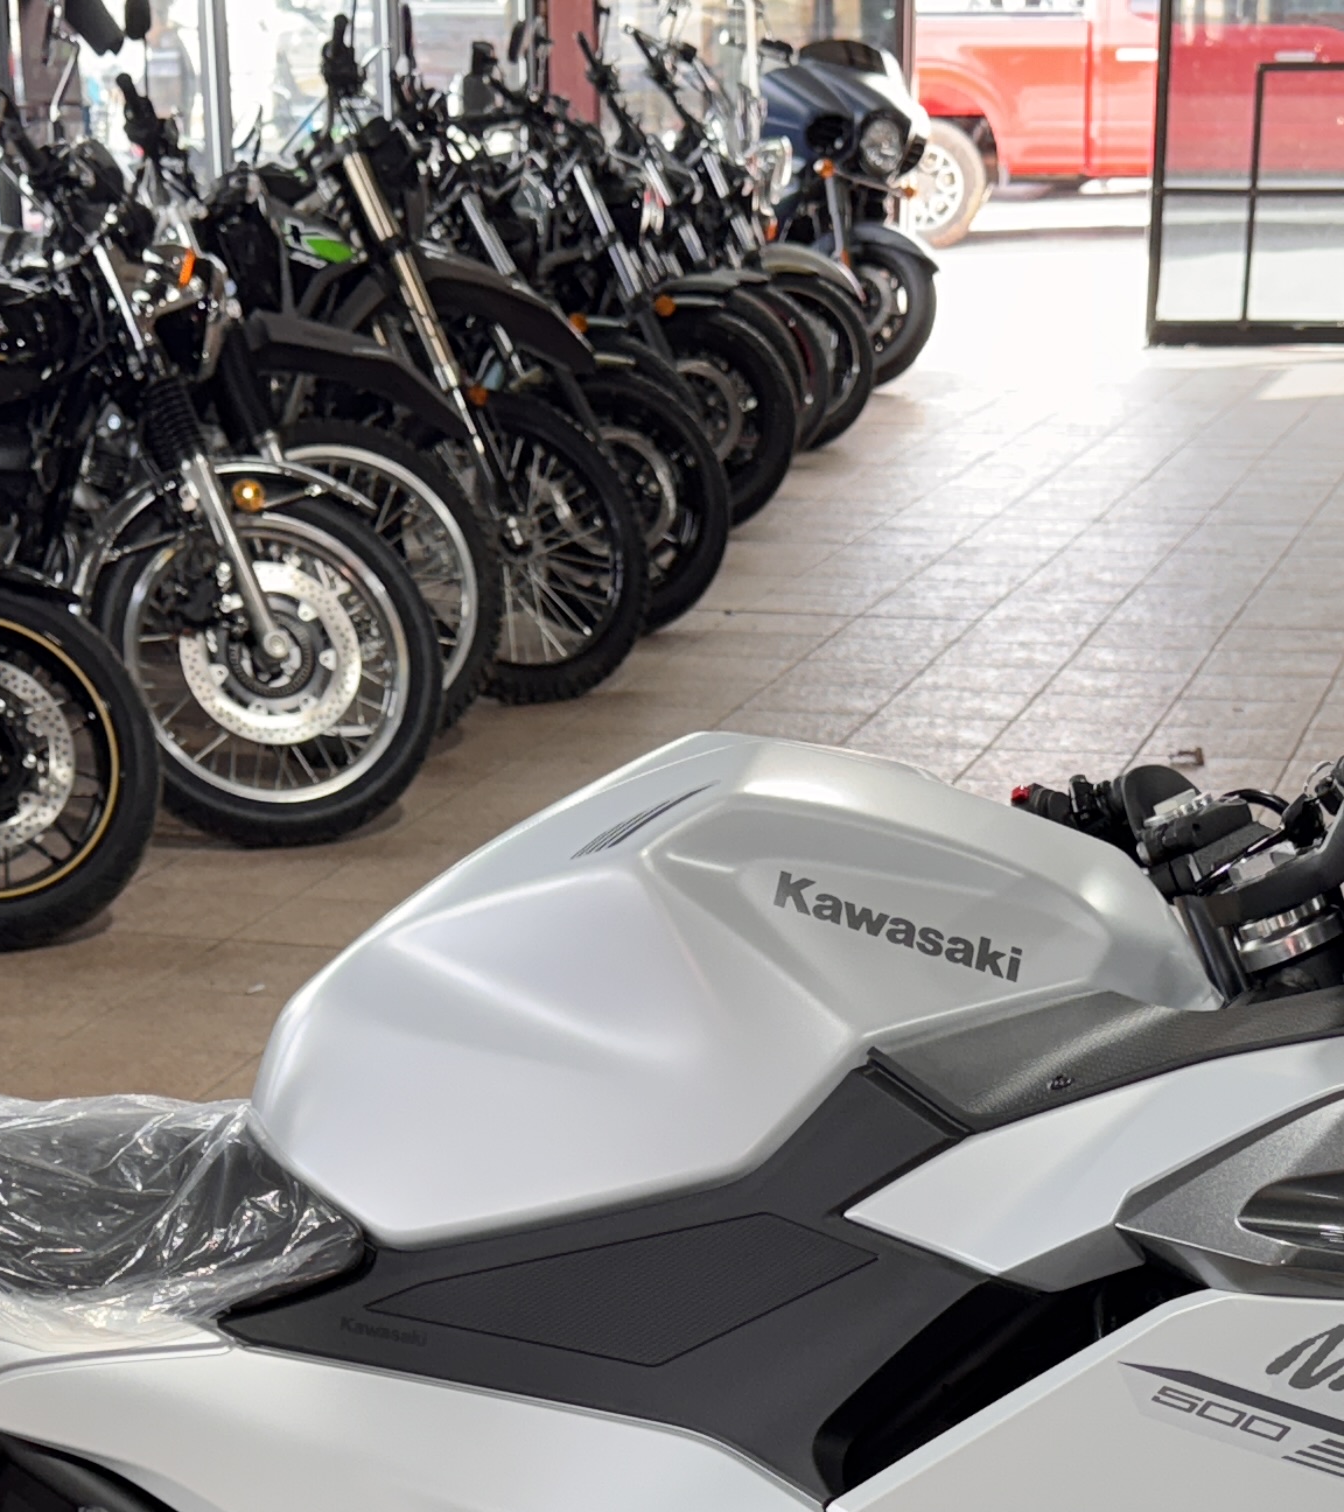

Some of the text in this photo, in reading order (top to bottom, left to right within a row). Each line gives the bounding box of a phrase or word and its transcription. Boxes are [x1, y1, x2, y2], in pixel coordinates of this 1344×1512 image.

[773, 870, 1023, 983] Kawasaki
[340, 1316, 428, 1347] Kawasaki
[1152, 1385, 1291, 1442] 500
